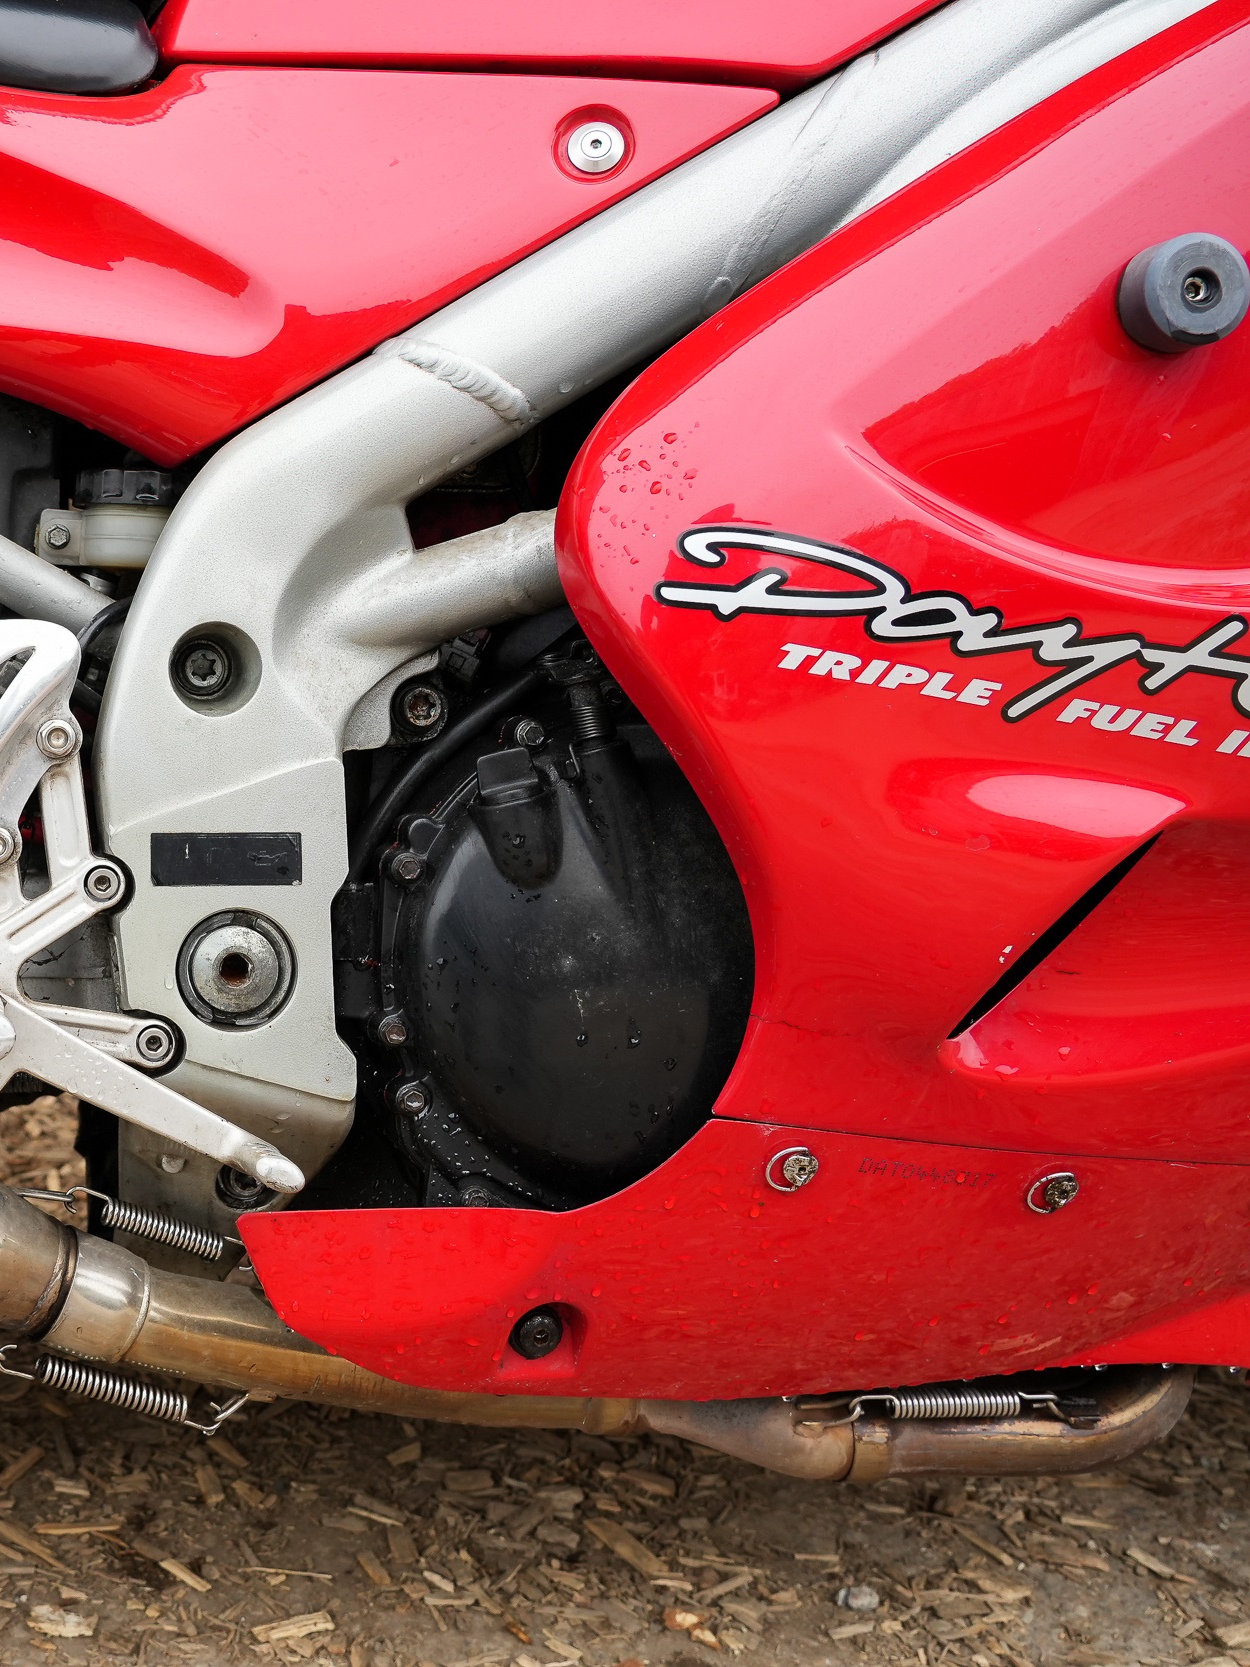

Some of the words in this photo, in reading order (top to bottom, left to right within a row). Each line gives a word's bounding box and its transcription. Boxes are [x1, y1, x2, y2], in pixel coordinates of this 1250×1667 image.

[654, 526, 1250, 723] Dayt
[779, 642, 1002, 707] TRIPLE
[1055, 698, 1200, 747] FUEL
[1215, 729, 1250, 758] I
